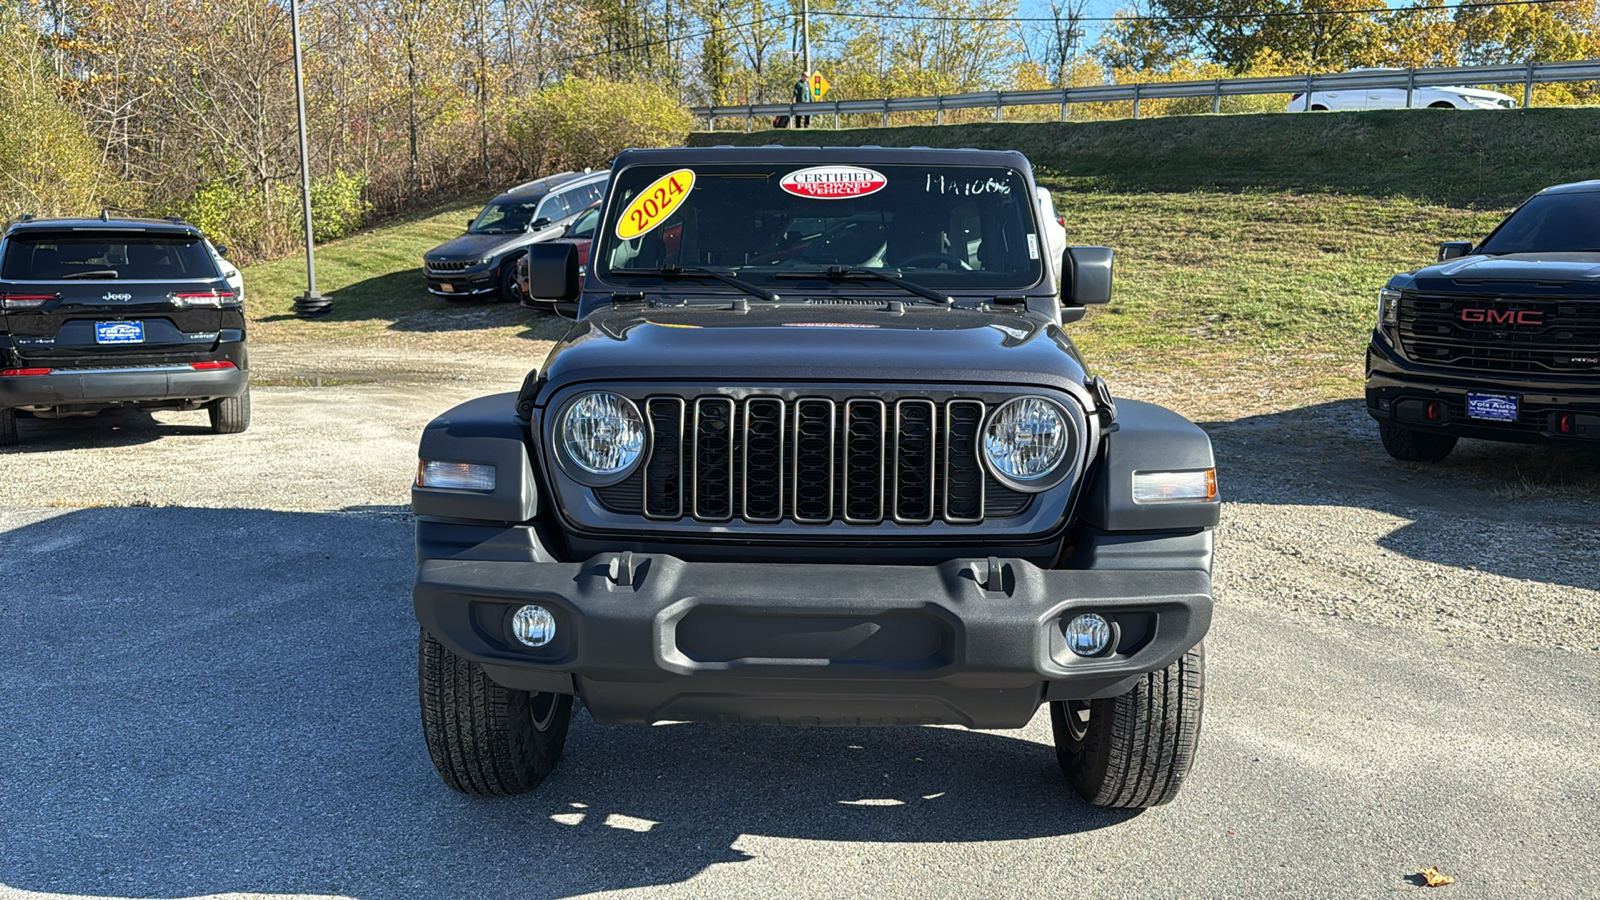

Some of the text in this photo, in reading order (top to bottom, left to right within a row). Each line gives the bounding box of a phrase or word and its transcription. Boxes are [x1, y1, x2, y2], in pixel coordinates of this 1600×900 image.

[793, 172, 874, 184] CERTIFIED
[797, 181, 871, 190] PRE-OWNED
[808, 187, 861, 195] VEHICLE
[630, 176, 684, 231] 2024
[102, 291, 132, 302] Jeep
[1461, 308, 1544, 325] GMC
[1491, 402, 1517, 410] Auto
